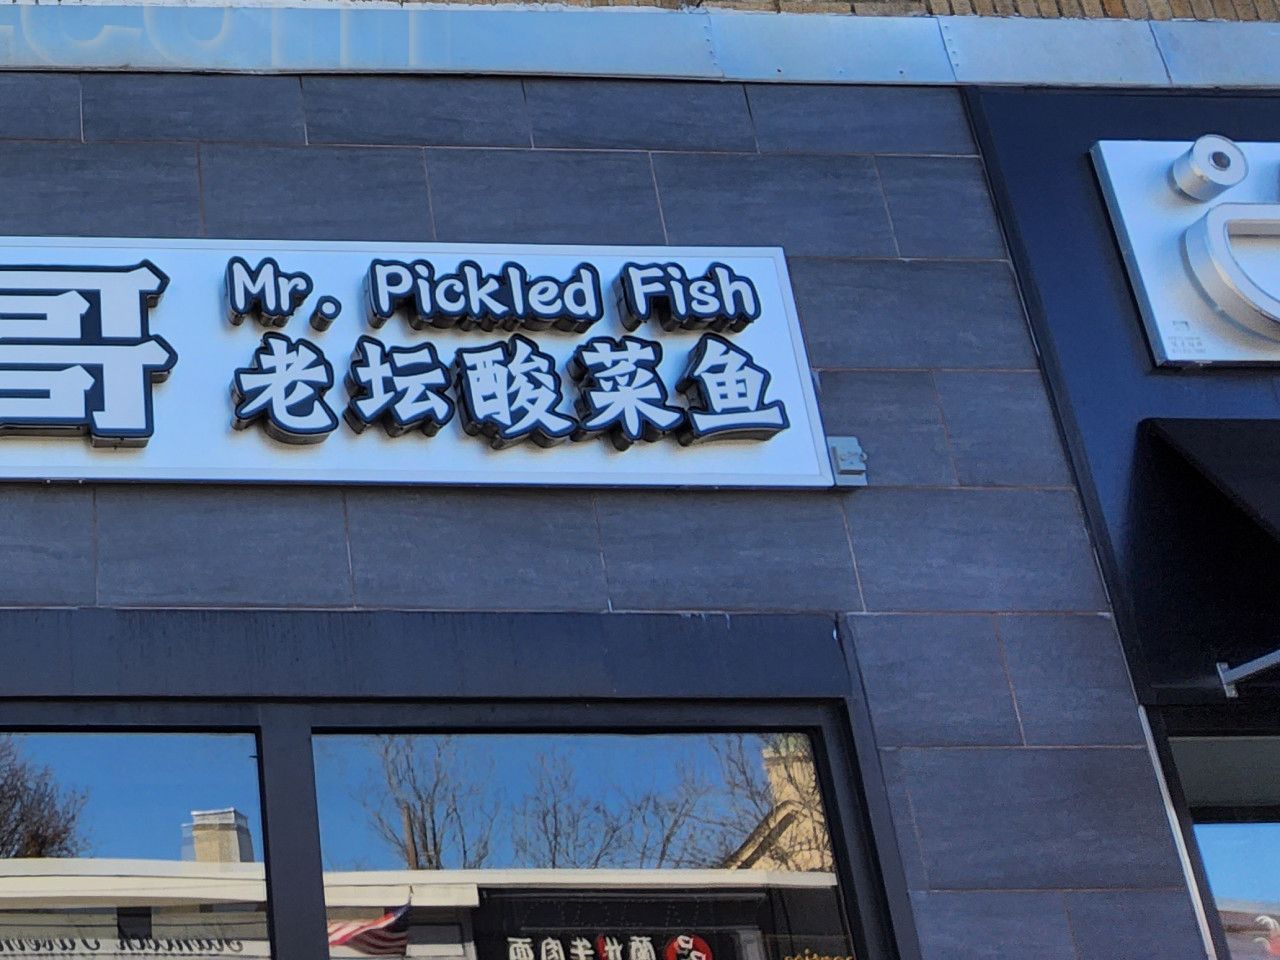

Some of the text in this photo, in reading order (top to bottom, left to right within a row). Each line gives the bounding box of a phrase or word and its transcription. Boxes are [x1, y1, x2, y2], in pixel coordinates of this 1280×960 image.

[225, 255, 762, 333] Mr. Pickled Fish
[231, 332, 791, 450] 老坛酸菜鱼
